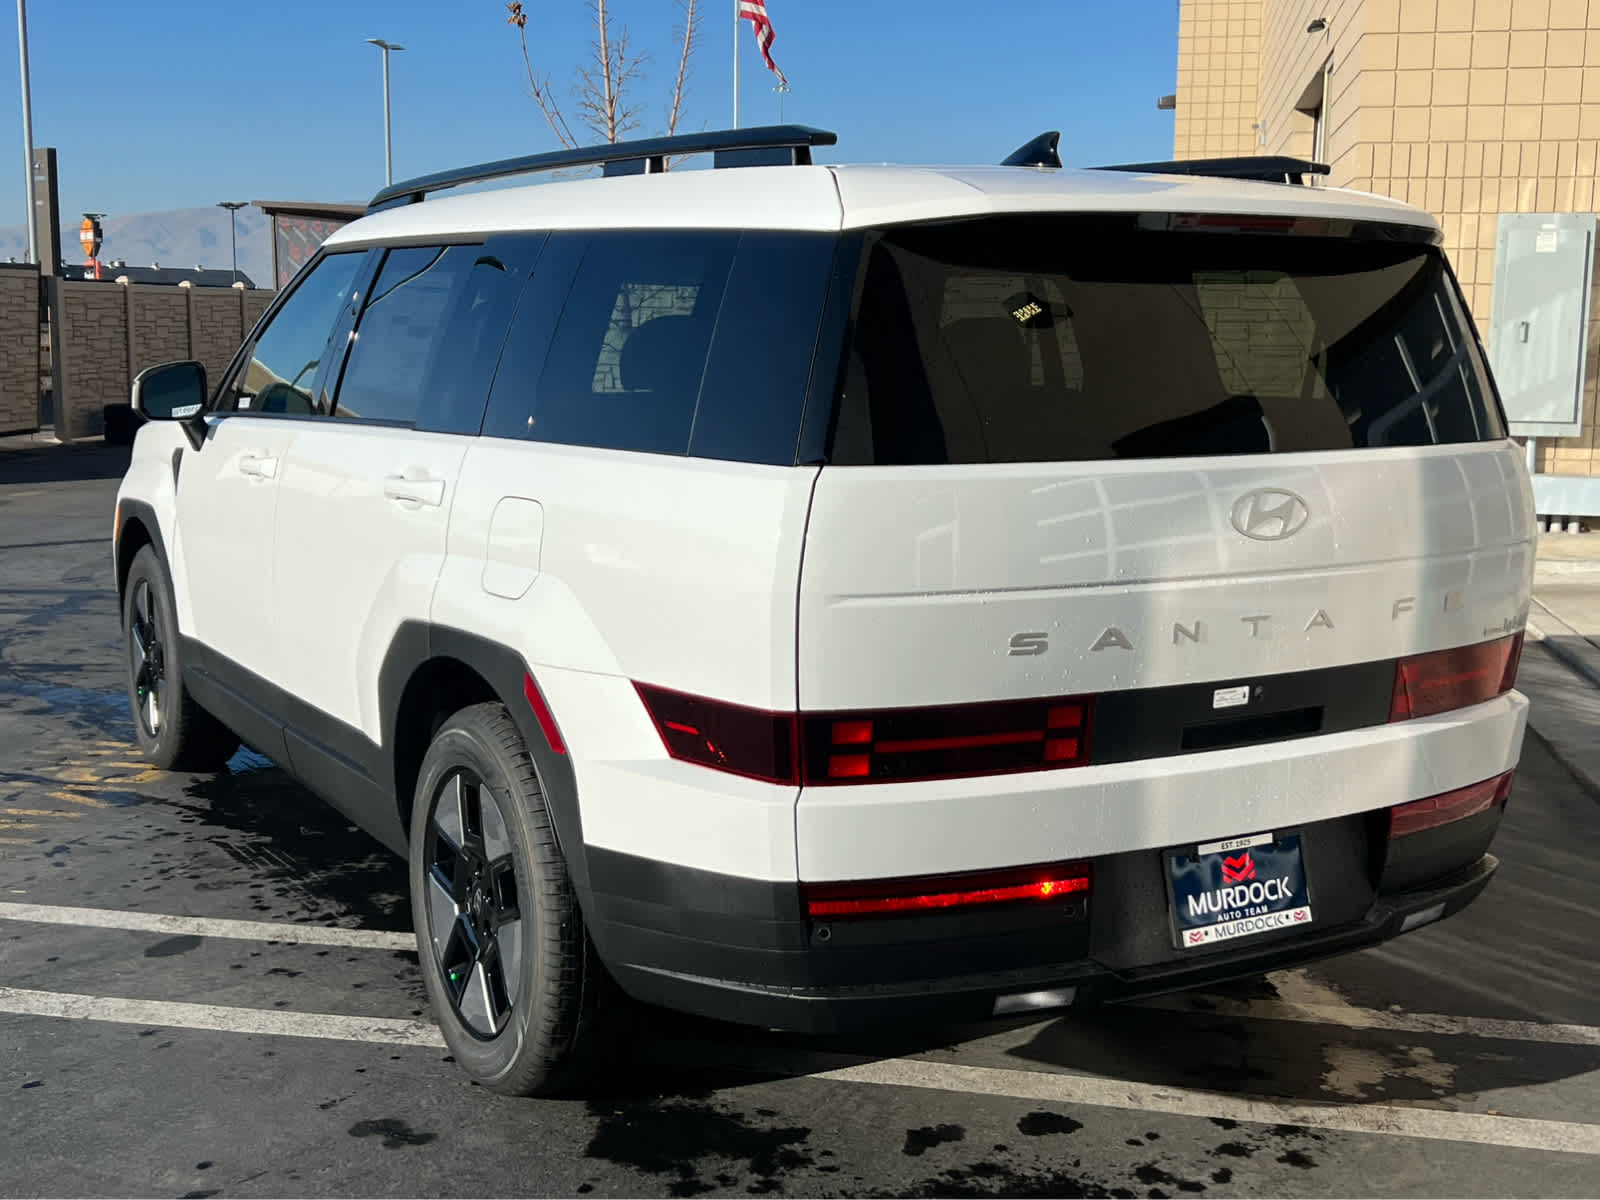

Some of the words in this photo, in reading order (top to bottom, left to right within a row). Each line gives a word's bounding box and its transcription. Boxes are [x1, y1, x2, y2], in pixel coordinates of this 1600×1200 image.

[1007, 608, 1335, 656] SANTA
[1187, 876, 1293, 917] MURDOCK
[1214, 914, 1285, 939] MURDOCK
[1217, 911, 1241, 922] AUTO
[1245, 905, 1268, 916] TEAM
